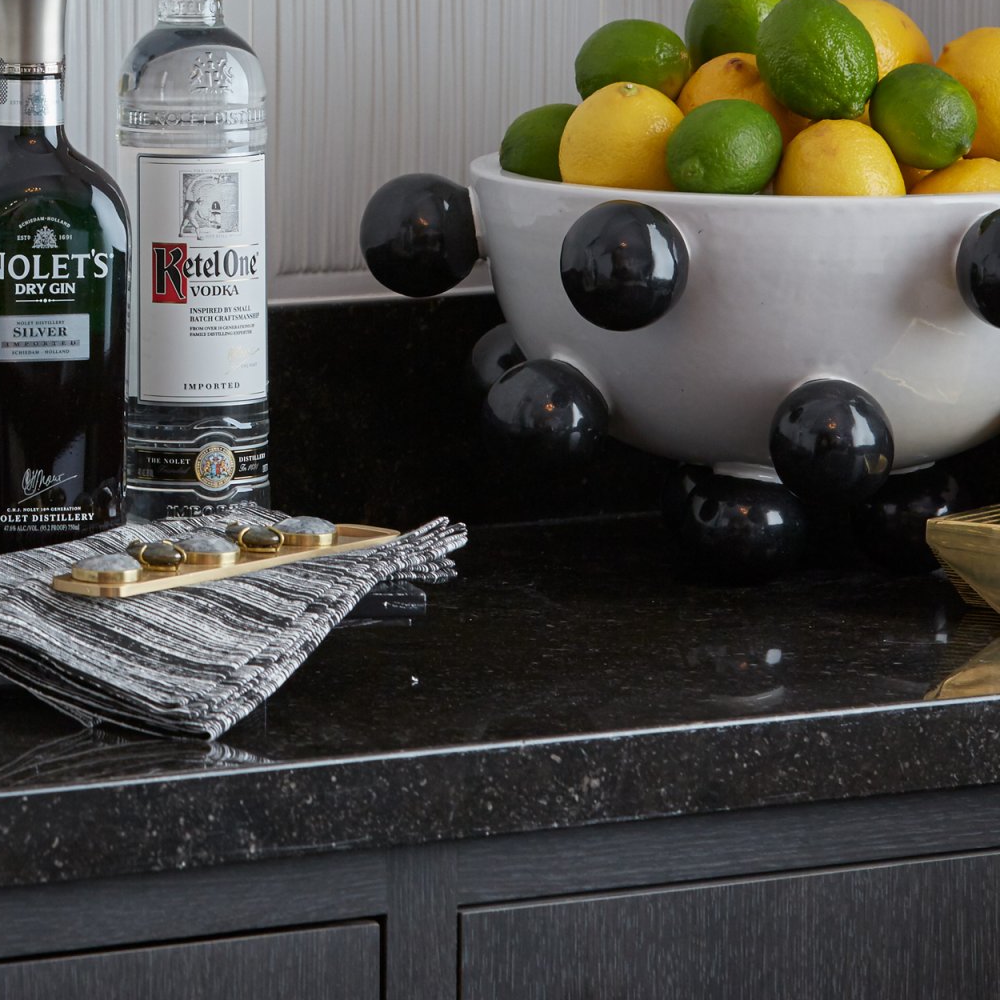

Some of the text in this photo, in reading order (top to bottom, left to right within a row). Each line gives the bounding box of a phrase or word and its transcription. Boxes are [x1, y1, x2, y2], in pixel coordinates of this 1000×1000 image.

[153, 247, 257, 300] Ketel One
[15, 282, 76, 295] DRY GIN
[190, 284, 239, 297] VODKA
[13, 327, 68, 338] SILVER
[6, 340, 77, 348] IMPORTED
[183, 381, 240, 390] IMPORTED
[32, 513, 95, 522] DISTILLERY
